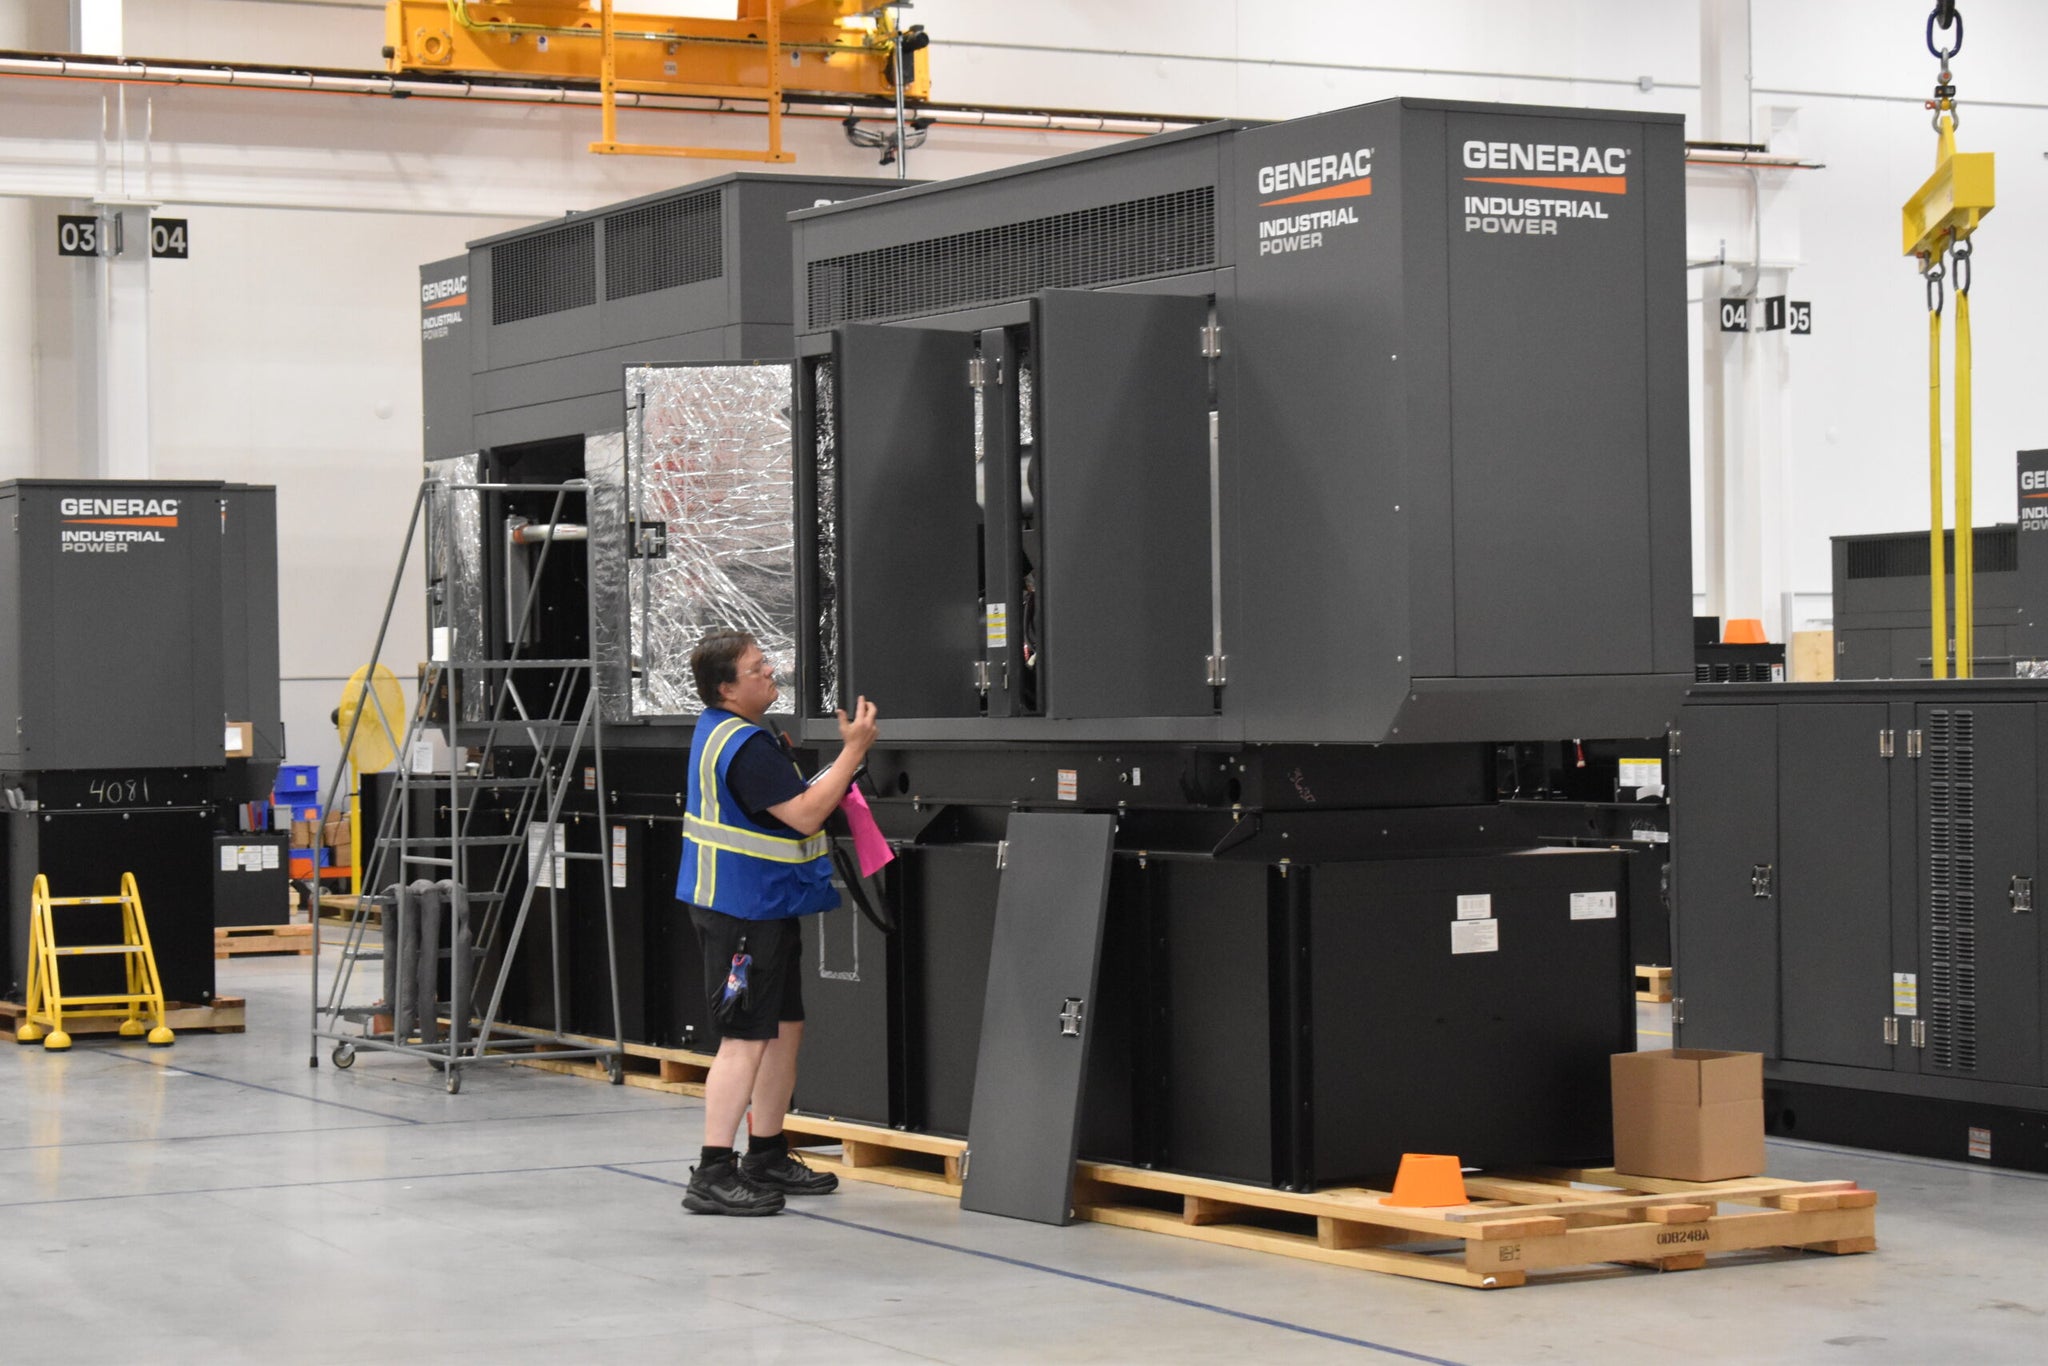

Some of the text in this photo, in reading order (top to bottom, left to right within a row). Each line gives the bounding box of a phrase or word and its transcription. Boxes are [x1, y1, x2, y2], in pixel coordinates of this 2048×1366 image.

[1463, 140, 1626, 175] GENERAC
[1258, 148, 1371, 194] GENERAC
[1464, 196, 1609, 219] INDUSTRIAL
[1259, 206, 1359, 239] INDUSTRIAL
[1465, 217, 1558, 235] POWER
[61, 223, 96, 251] 03
[152, 225, 186, 253] 04
[1260, 232, 1323, 256] POWER
[422, 275, 468, 302] GENERAC
[423, 311, 463, 330] INDUSTRIAL
[1721, 304, 1747, 328] 04
[2021, 470, 2048, 490] GE
[60, 498, 179, 516] GENERAC
[61, 531, 165, 542] INDUSTRIAL
[61, 542, 129, 553] POWER
[89, 776, 149, 803] 4081
